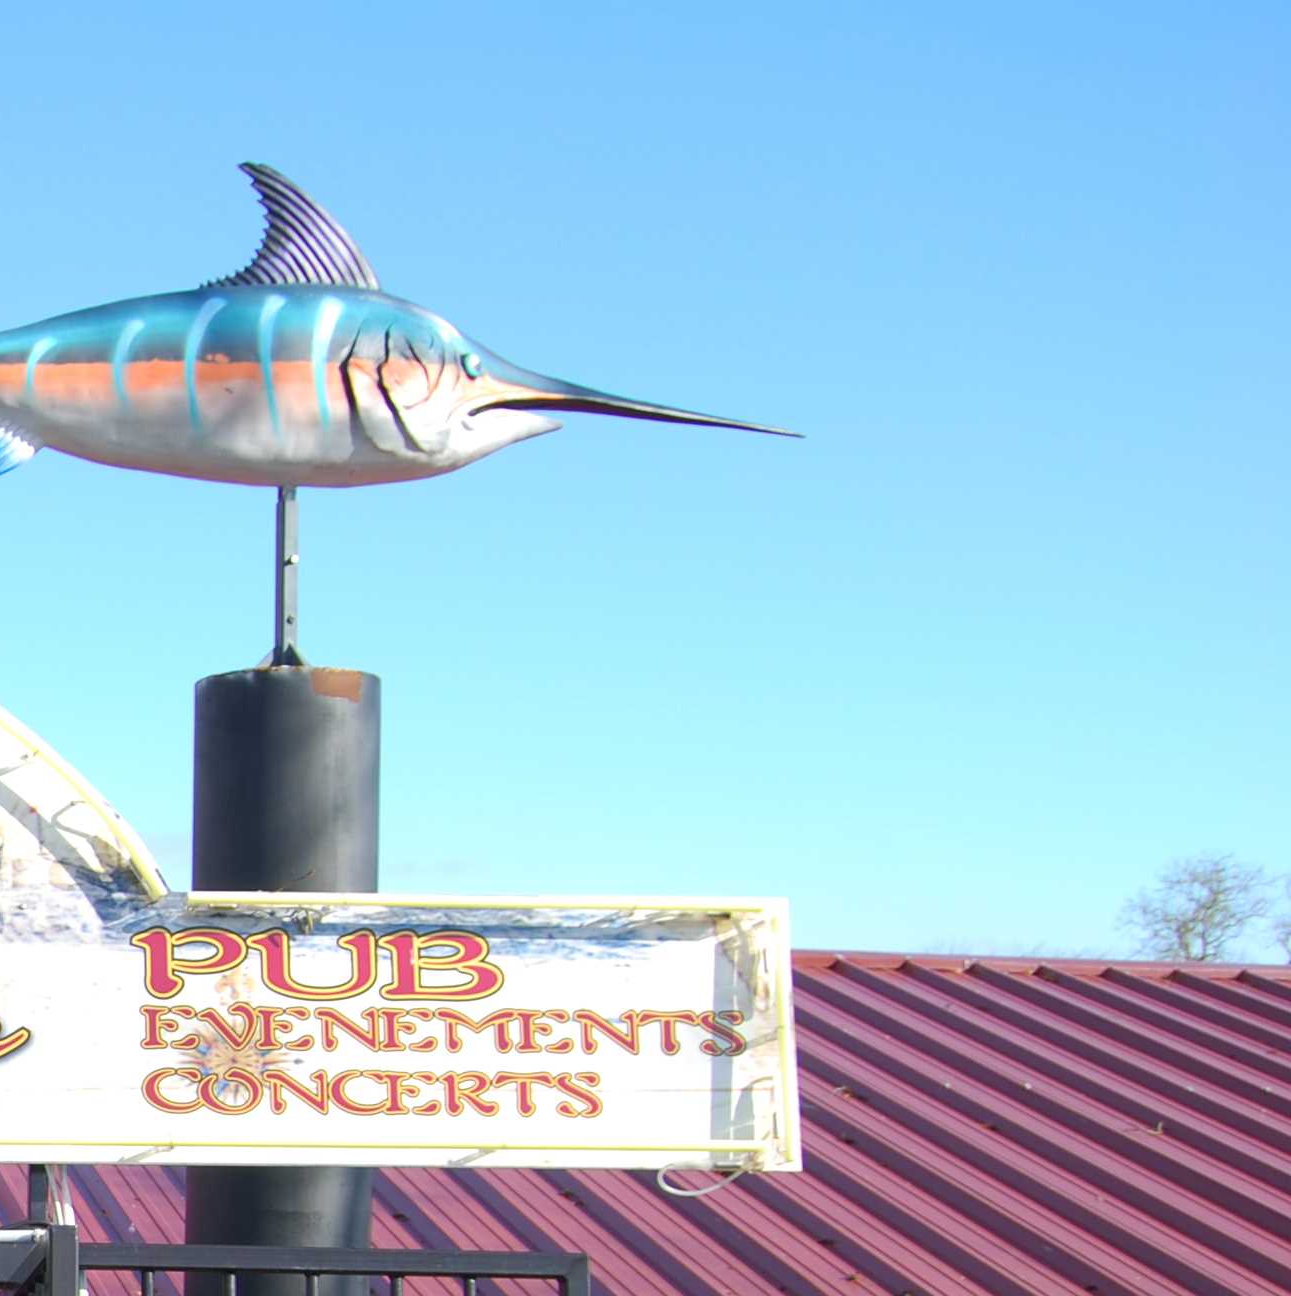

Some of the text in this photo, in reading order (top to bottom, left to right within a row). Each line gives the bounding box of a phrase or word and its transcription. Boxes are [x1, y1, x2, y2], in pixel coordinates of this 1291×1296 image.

[130, 927, 505, 1001] PUB
[140, 1002, 747, 1056] EVENEMENTS
[141, 1068, 604, 1118] CONCERTS
